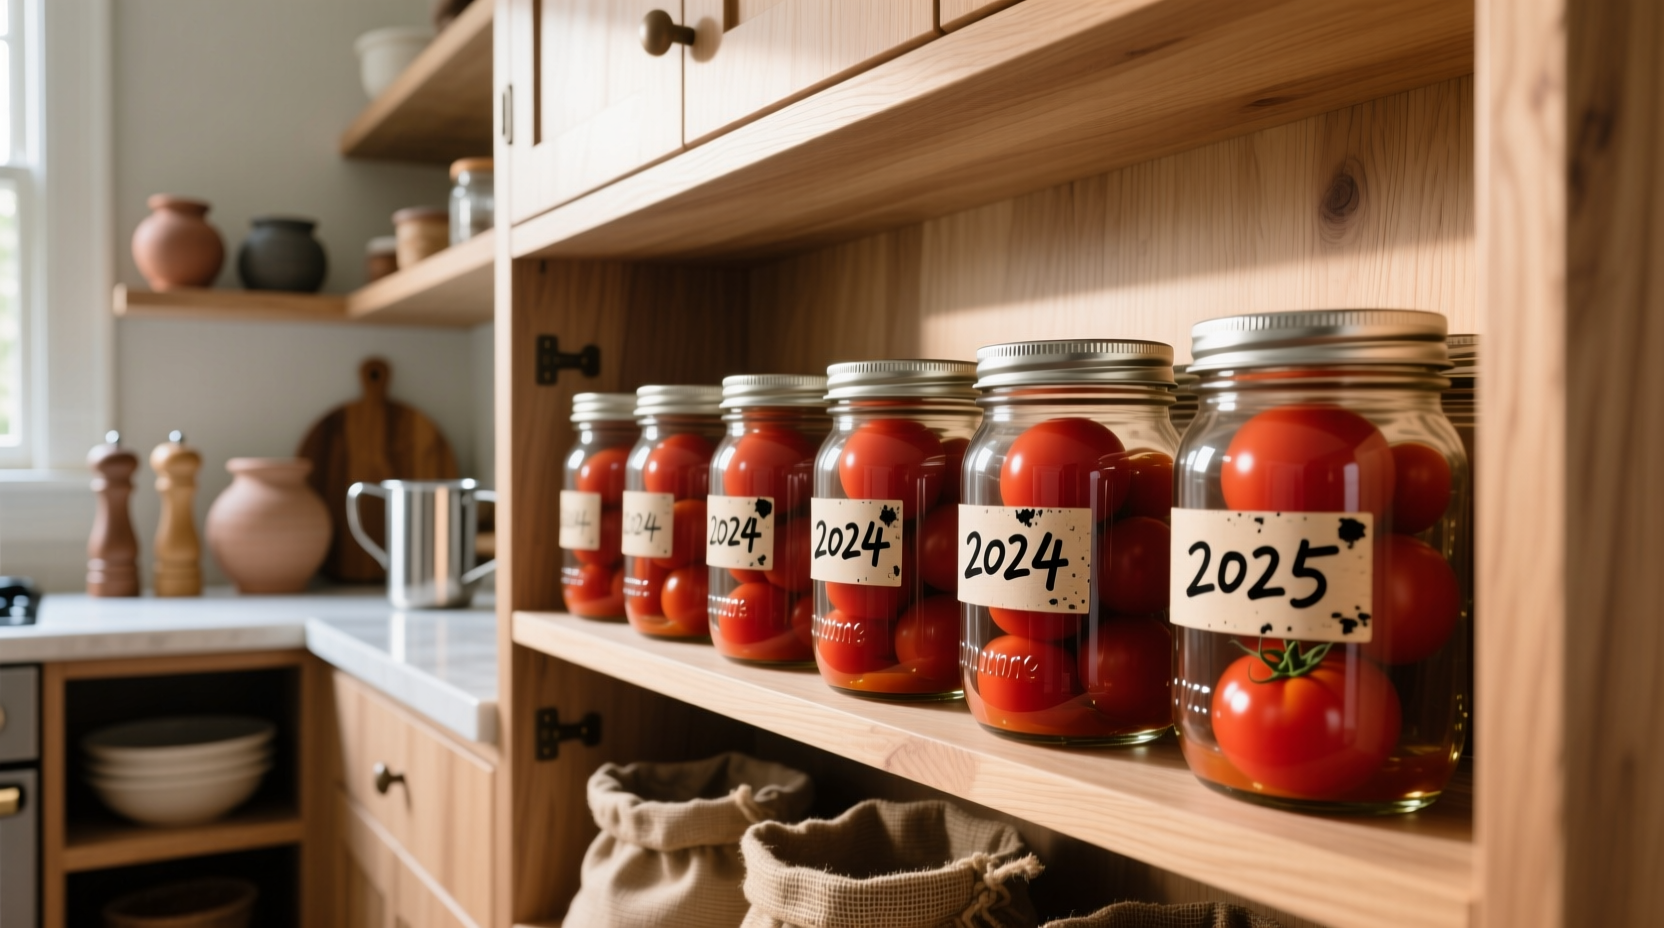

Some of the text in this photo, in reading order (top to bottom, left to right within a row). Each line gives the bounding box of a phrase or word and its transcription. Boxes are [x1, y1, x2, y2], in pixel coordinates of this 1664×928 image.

[709, 515, 762, 553] 2024
[814, 519, 891, 568] 2024
[964, 530, 1069, 592] 2024
[1186, 538, 1340, 609] 2025
